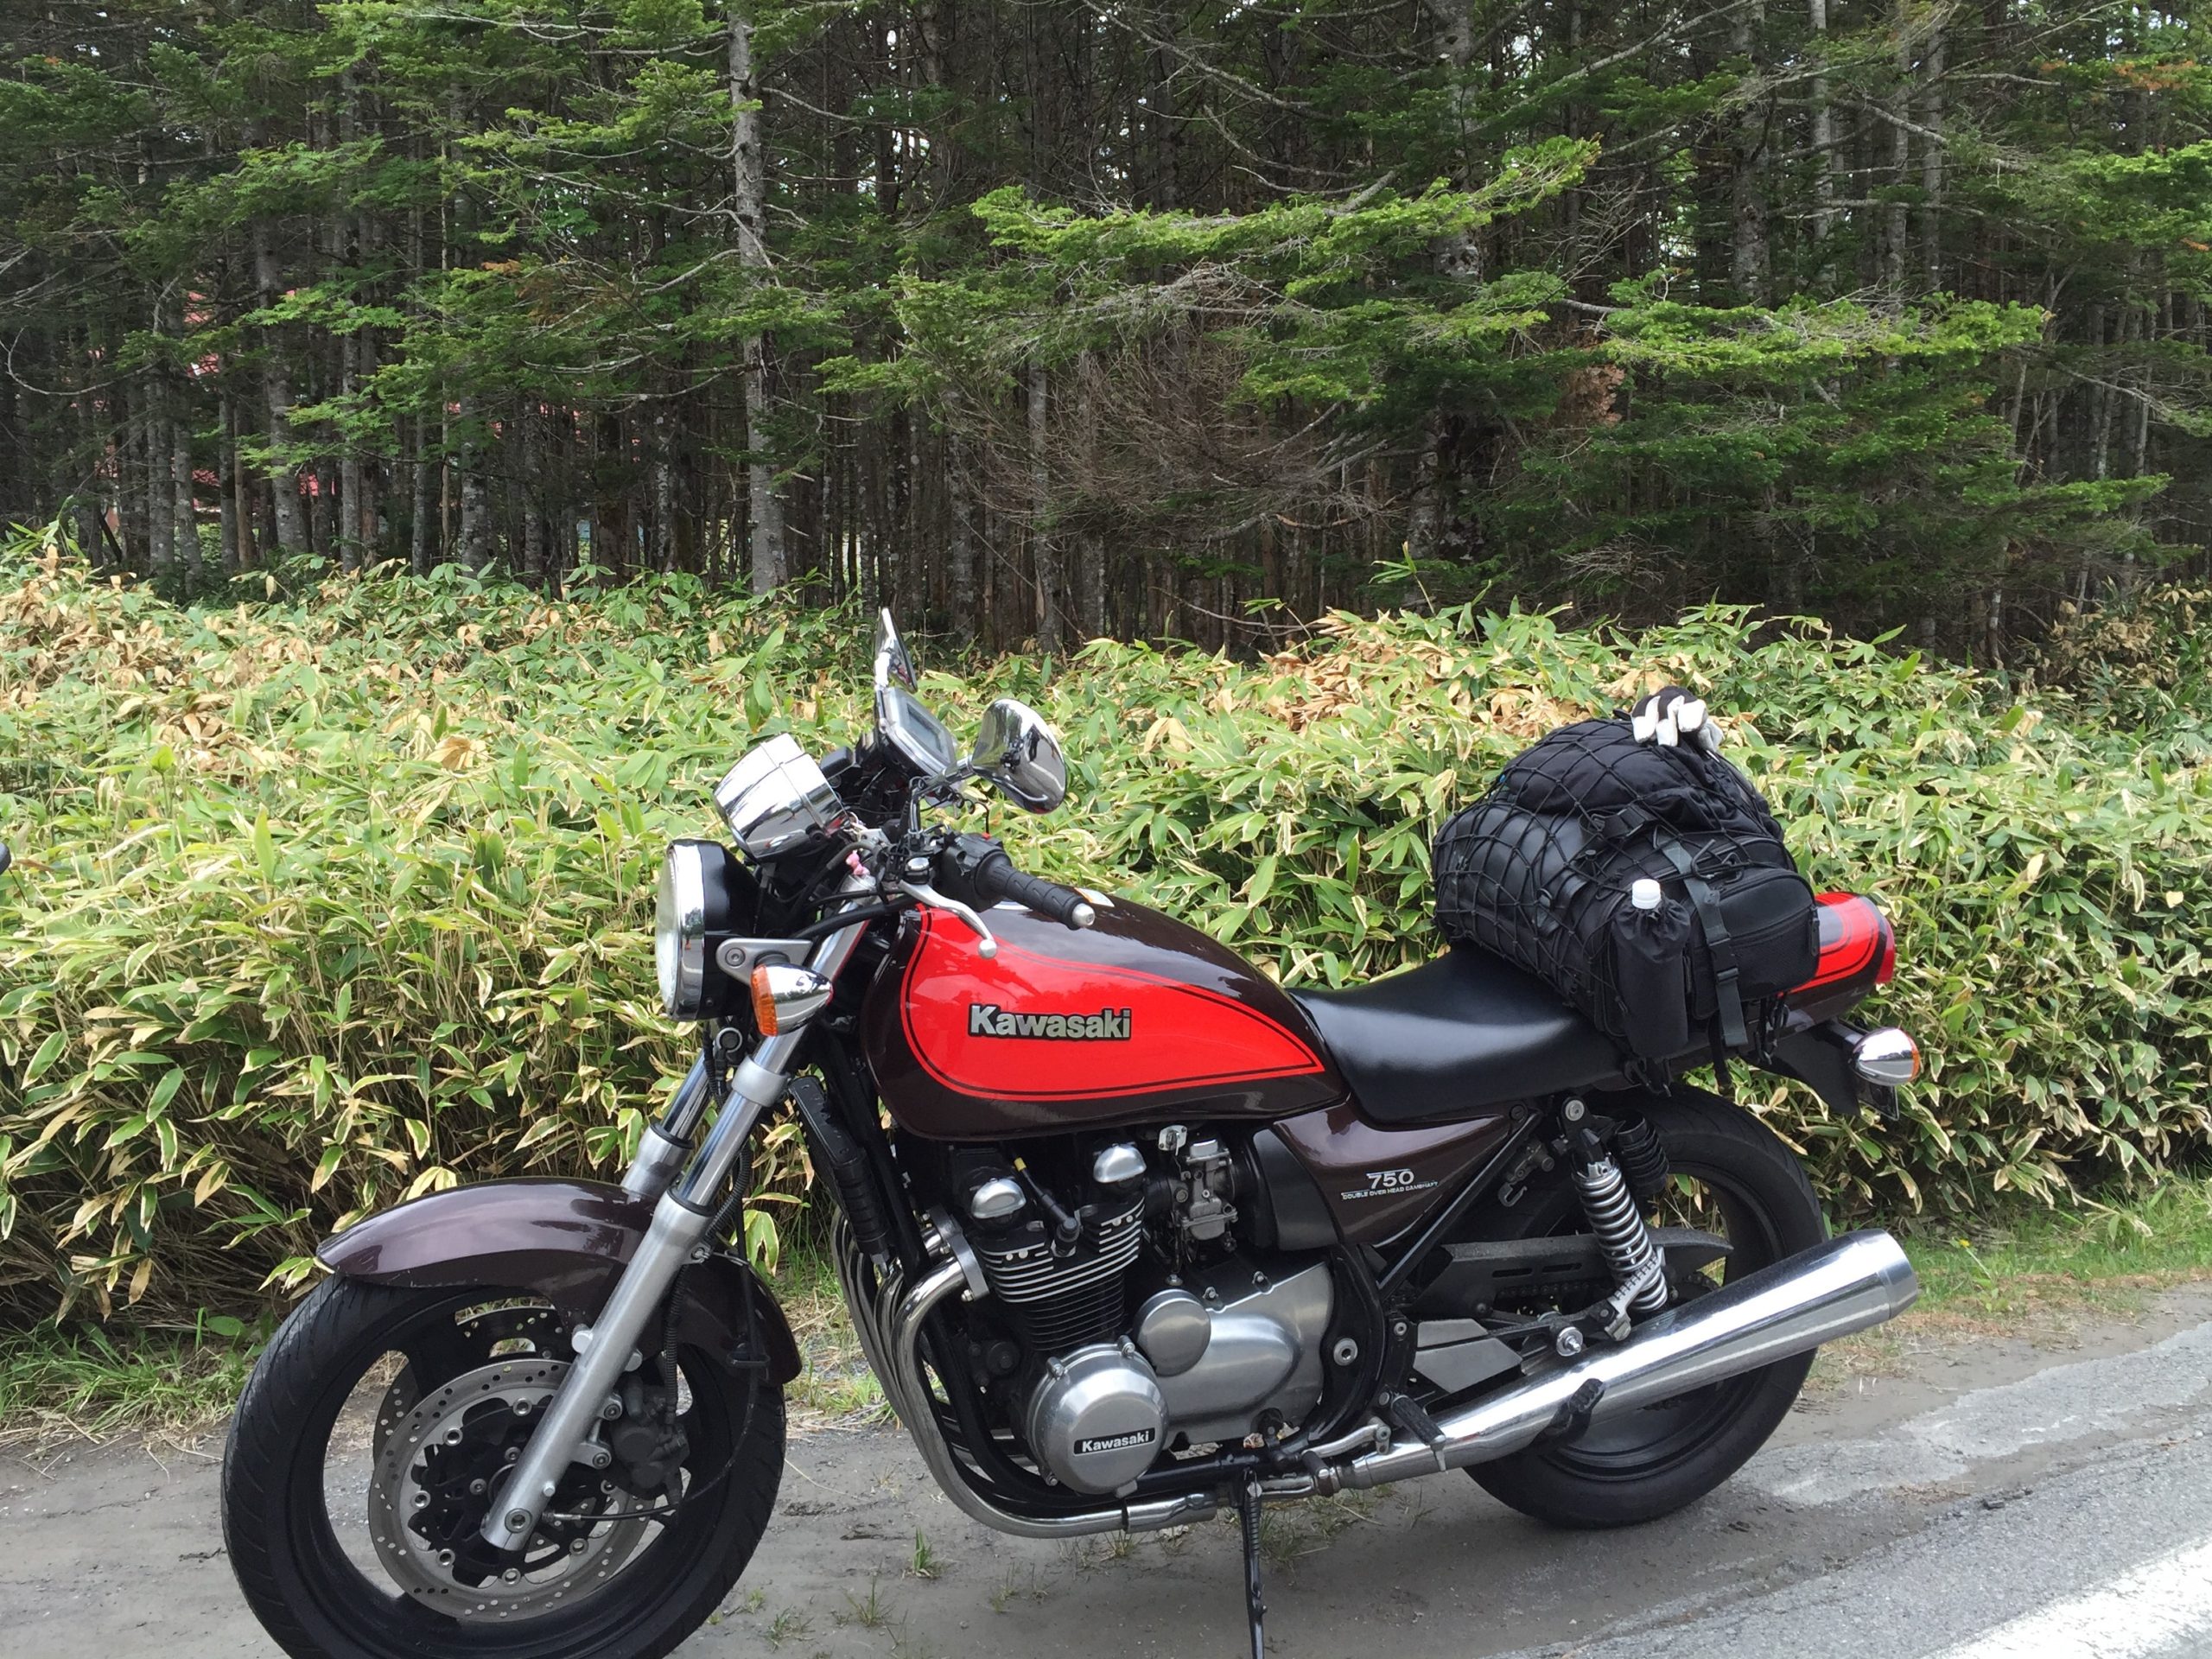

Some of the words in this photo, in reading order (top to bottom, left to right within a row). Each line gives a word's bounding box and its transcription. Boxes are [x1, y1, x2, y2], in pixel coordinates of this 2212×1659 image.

[969, 1004, 1132, 1039] Kawasaki
[1368, 1170, 1414, 1189] 750
[1342, 1192, 1369, 1200] DOUBLE
[1082, 1431, 1149, 1452] Kawasaki
